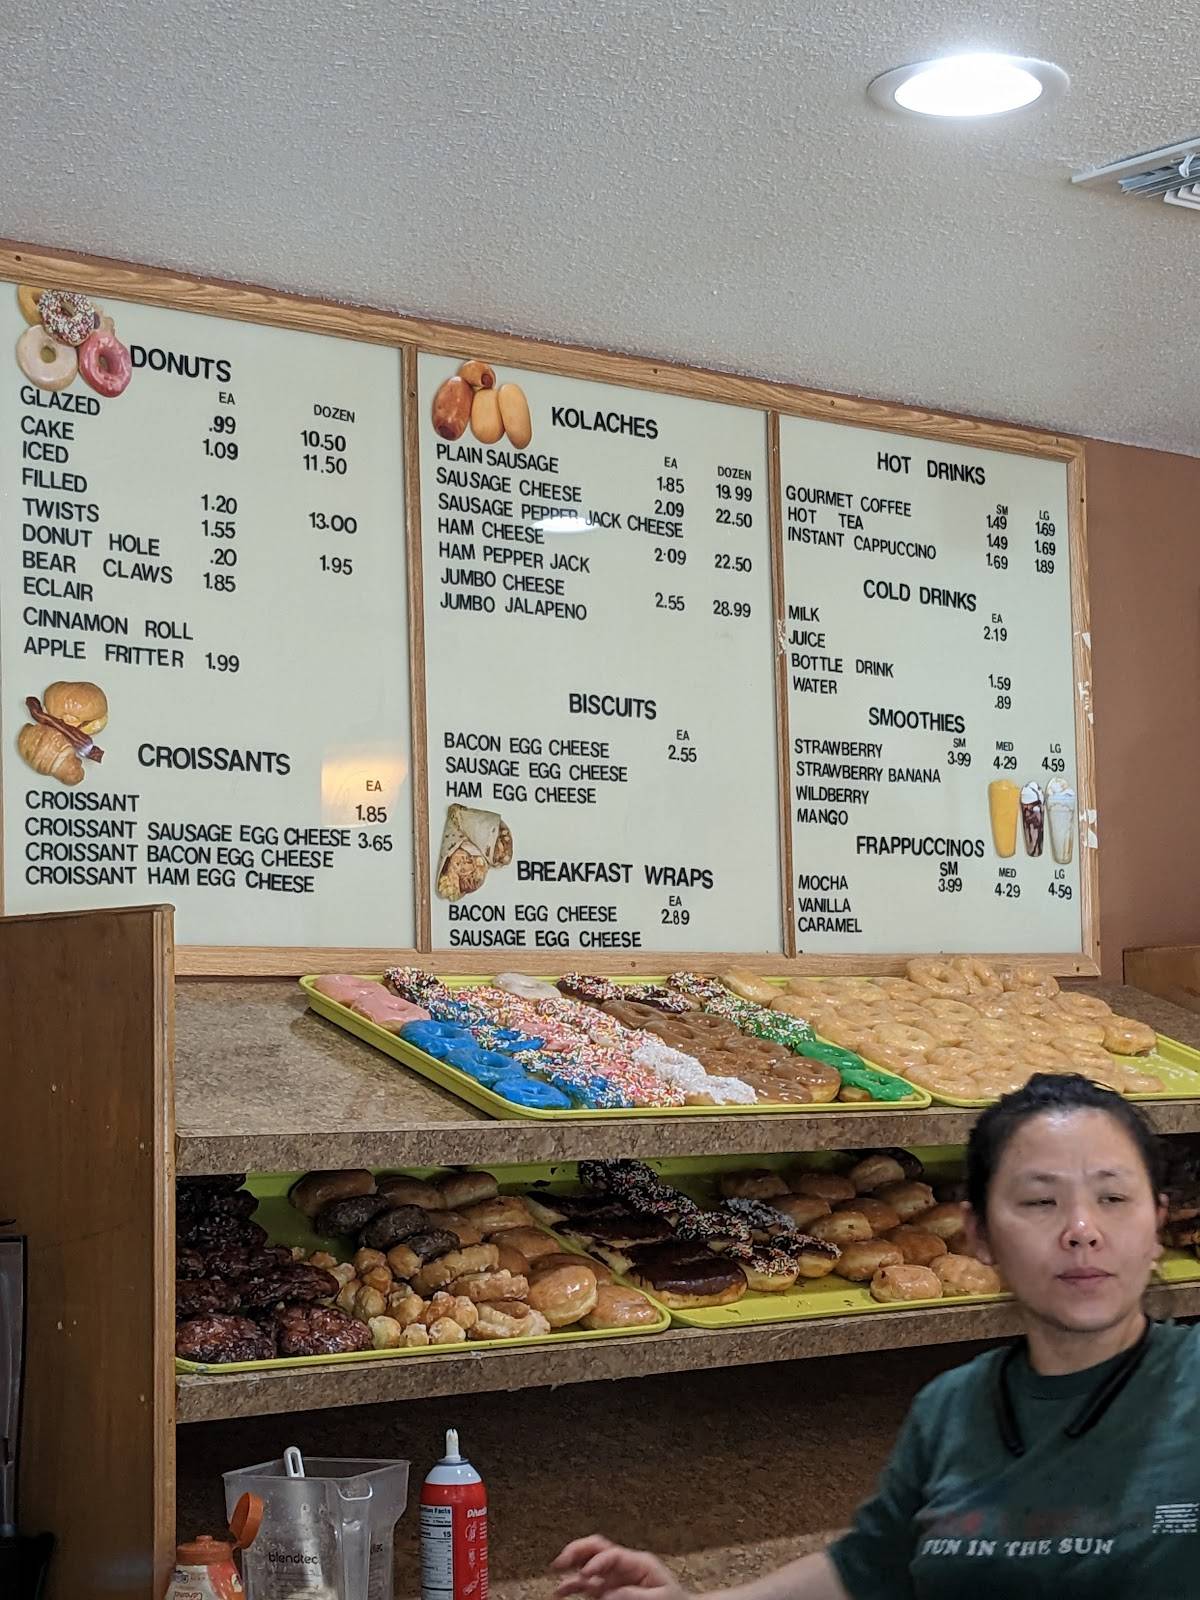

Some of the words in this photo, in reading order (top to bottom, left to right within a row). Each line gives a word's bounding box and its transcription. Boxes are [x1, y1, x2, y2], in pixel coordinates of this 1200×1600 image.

[131, 345, 231, 383] DONUTS
[19, 385, 100, 415] GLAZED
[219, 391, 235, 405] EA
[314, 404, 355, 423] DOZEN
[552, 407, 658, 439] KOLACHES
[21, 415, 74, 441] CAKE
[209, 416, 236, 434] .99
[202, 438, 238, 461] 1.09
[300, 430, 346, 452] 10.50
[23, 440, 69, 463] ICED
[436, 443, 483, 464] PLAIN
[486, 449, 559, 474] SAUSAGE
[303, 454, 347, 475] 11.50
[664, 456, 678, 469] EA
[877, 451, 911, 474] HOT
[927, 460, 985, 485] DRINKS
[22, 467, 87, 493] FILLED
[718, 466, 751, 481] DOZEN
[436, 467, 511, 493] SAUSAGE
[519, 480, 582, 503] CHEESE
[716, 483, 752, 502] 19.99
[22, 497, 99, 523] TWISTS
[201, 494, 237, 515] 1.20
[786, 485, 853, 509] GOURMET
[860, 496, 911, 517] COFFEE
[996, 504, 1008, 515] SM
[309, 512, 357, 534] 13.00
[438, 492, 513, 517] SAUSAGE
[585, 510, 622, 529] JACK
[627, 515, 684, 538] CHEESE
[716, 508, 752, 528] 22.50
[788, 506, 817, 524] HOT
[838, 513, 864, 530] TEA
[986, 513, 1008, 530] 1.49
[1039, 510, 1049, 521] LG
[202, 520, 236, 539] 1.55
[438, 517, 474, 535] HAM
[482, 521, 545, 544] CHEESE
[23, 523, 93, 548] DONUT
[109, 533, 160, 557] HOLE
[788, 526, 845, 548] INSTANT
[854, 535, 936, 560] CAPPUCCINO
[986, 533, 1008, 550] 1.49
[1035, 539, 1056, 556] 1.69
[210, 548, 237, 566] .20
[320, 555, 353, 575] 1.95
[439, 541, 475, 560] HAM
[483, 545, 543, 569] PEPPER
[550, 553, 590, 573] JACK
[715, 554, 752, 573] 22.50
[986, 552, 1008, 570] 1.69
[23, 550, 76, 574] BEAR
[103, 558, 173, 584] CLAWS
[24, 576, 93, 602] ECLAIR
[203, 572, 236, 592] 1.85
[440, 567, 496, 588] JUMBO
[502, 573, 565, 596] CHEESE
[655, 592, 685, 611] 2.55
[863, 579, 911, 602] COLD
[919, 586, 976, 612] DRINKS
[440, 592, 495, 613] JUMBO
[505, 597, 587, 620] JALAPENO
[713, 600, 751, 618] 28.99
[788, 605, 820, 622] MILK
[23, 606, 128, 635] CINNAMON
[145, 620, 193, 640] ROLL
[992, 613, 1003, 623] EA
[788, 630, 825, 648] JUICE
[984, 626, 1007, 642] 2.19
[24, 636, 86, 659] APPLE
[105, 643, 184, 668] FRITTER
[205, 652, 239, 673] 1.99
[791, 653, 843, 674] BOTTLE
[856, 659, 894, 678] DRINK
[793, 675, 837, 694] WATER
[988, 674, 1011, 691] 1.59
[569, 693, 656, 720] BISCUITS
[994, 695, 1011, 710] .89
[869, 707, 965, 734] SMOOTHIES
[676, 729, 690, 741] EA
[953, 737, 966, 748] SM
[444, 732, 501, 752] BACON
[509, 737, 542, 755] EGG
[548, 739, 610, 758] CHEESE
[668, 744, 697, 763] 2.55
[794, 738, 883, 758] STRAWBERRY
[996, 741, 1014, 751] MED
[1050, 744, 1061, 753] LG
[138, 743, 290, 775] CROISSANTS
[947, 751, 971, 767] 3.99
[993, 756, 1017, 770] 4.29
[1042, 757, 1065, 772] 4.59
[445, 756, 520, 777] SAUSAGE
[529, 762, 561, 780] EGG
[569, 764, 628, 782] CHEESE
[796, 761, 883, 782] STRAWBERRY
[888, 768, 941, 783] BANANA
[366, 780, 382, 792] EA
[446, 780, 482, 798] HAM
[493, 783, 527, 802] EGG
[535, 786, 596, 804] CHEESE
[796, 785, 869, 805] WILDBERRY
[25, 790, 140, 812] CROISSANT
[355, 804, 387, 823] 1.85
[797, 808, 848, 825] MANGO
[25, 817, 137, 839] CROISSANT
[147, 822, 232, 842] SAUSAGE
[240, 825, 278, 846] EGG
[284, 827, 351, 847] CHEESE
[358, 832, 393, 852] 3.65
[25, 842, 139, 862] CROISSANT
[147, 845, 211, 865] BACON
[217, 847, 254, 868] EGG
[261, 848, 334, 869] CHEESE
[856, 835, 985, 858] FRAPPUCCINOS
[517, 860, 633, 883] BREAKFAST
[644, 865, 713, 889] WRAPS
[940, 861, 958, 877] SM
[999, 867, 1016, 878] MED
[1055, 869, 1065, 880] LG
[25, 865, 137, 886] CROISSANT
[148, 867, 190, 885] HAM
[197, 868, 235, 887] EGG
[245, 870, 314, 893] CHEESE
[798, 874, 848, 891] MOCHA
[938, 877, 962, 893] 3.99
[995, 883, 1021, 898] 4.29
[1048, 882, 1072, 900] 4.59
[669, 895, 682, 907] EA
[798, 897, 851, 913] VANILLA
[449, 904, 505, 922] BACON
[515, 904, 548, 922] EGG
[557, 905, 617, 923] CHEESE
[661, 908, 690, 925] 2.89
[798, 917, 862, 933] CARAMEL
[450, 929, 526, 947] SAUSAGE
[535, 930, 569, 947] EGG
[579, 931, 642, 948] CHEESE
[966, 1539, 998, 1557] IN
[1004, 1539, 1052, 1557] THE
[1057, 1537, 1115, 1555] SUN
[268, 1551, 318, 1565] blendtec
